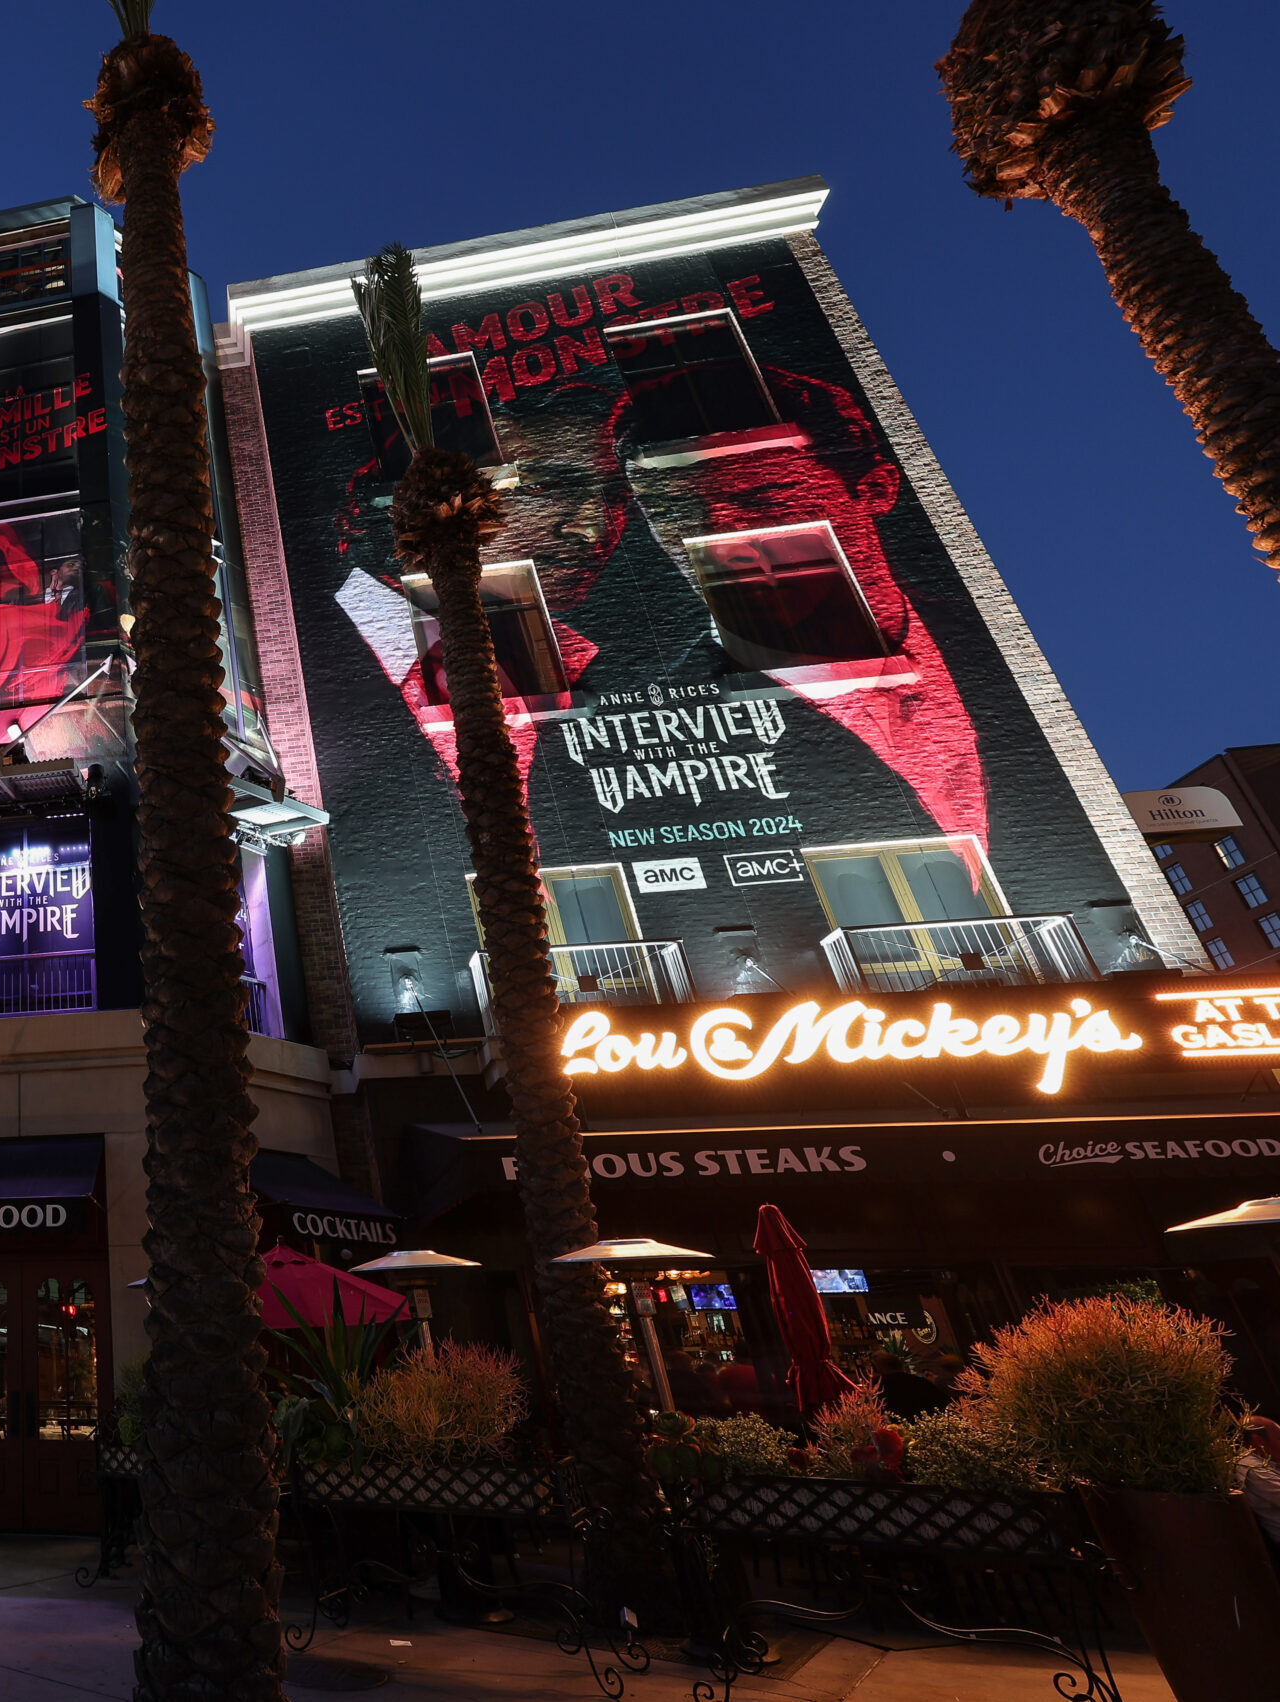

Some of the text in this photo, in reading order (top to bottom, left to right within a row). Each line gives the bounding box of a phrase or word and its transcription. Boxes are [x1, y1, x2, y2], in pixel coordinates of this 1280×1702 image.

[448, 274, 775, 419] MONSTRE
[5, 385, 25, 402] LA
[25, 415, 50, 435] UN
[325, 397, 384, 432] EST
[600, 683, 721, 706] ANNE RICE'S
[560, 698, 787, 766] INTERVIEW
[633, 740, 721, 761] WITH THE
[590, 751, 791, 814] VAMPIRE
[1148, 808, 1206, 821] Hilton
[608, 815, 803, 849] NEW SEASON 2024
[29, 895, 49, 905] THE
[1194, 998, 1245, 1022] AT
[560, 1010, 688, 1076] Lou
[780, 998, 1144, 1095] Mickey's
[694, 1145, 869, 1177] STEAKS
[1038, 1138, 1280, 1166] Choice SEAFOOD
[292, 1211, 397, 1245] COCKTAILS
